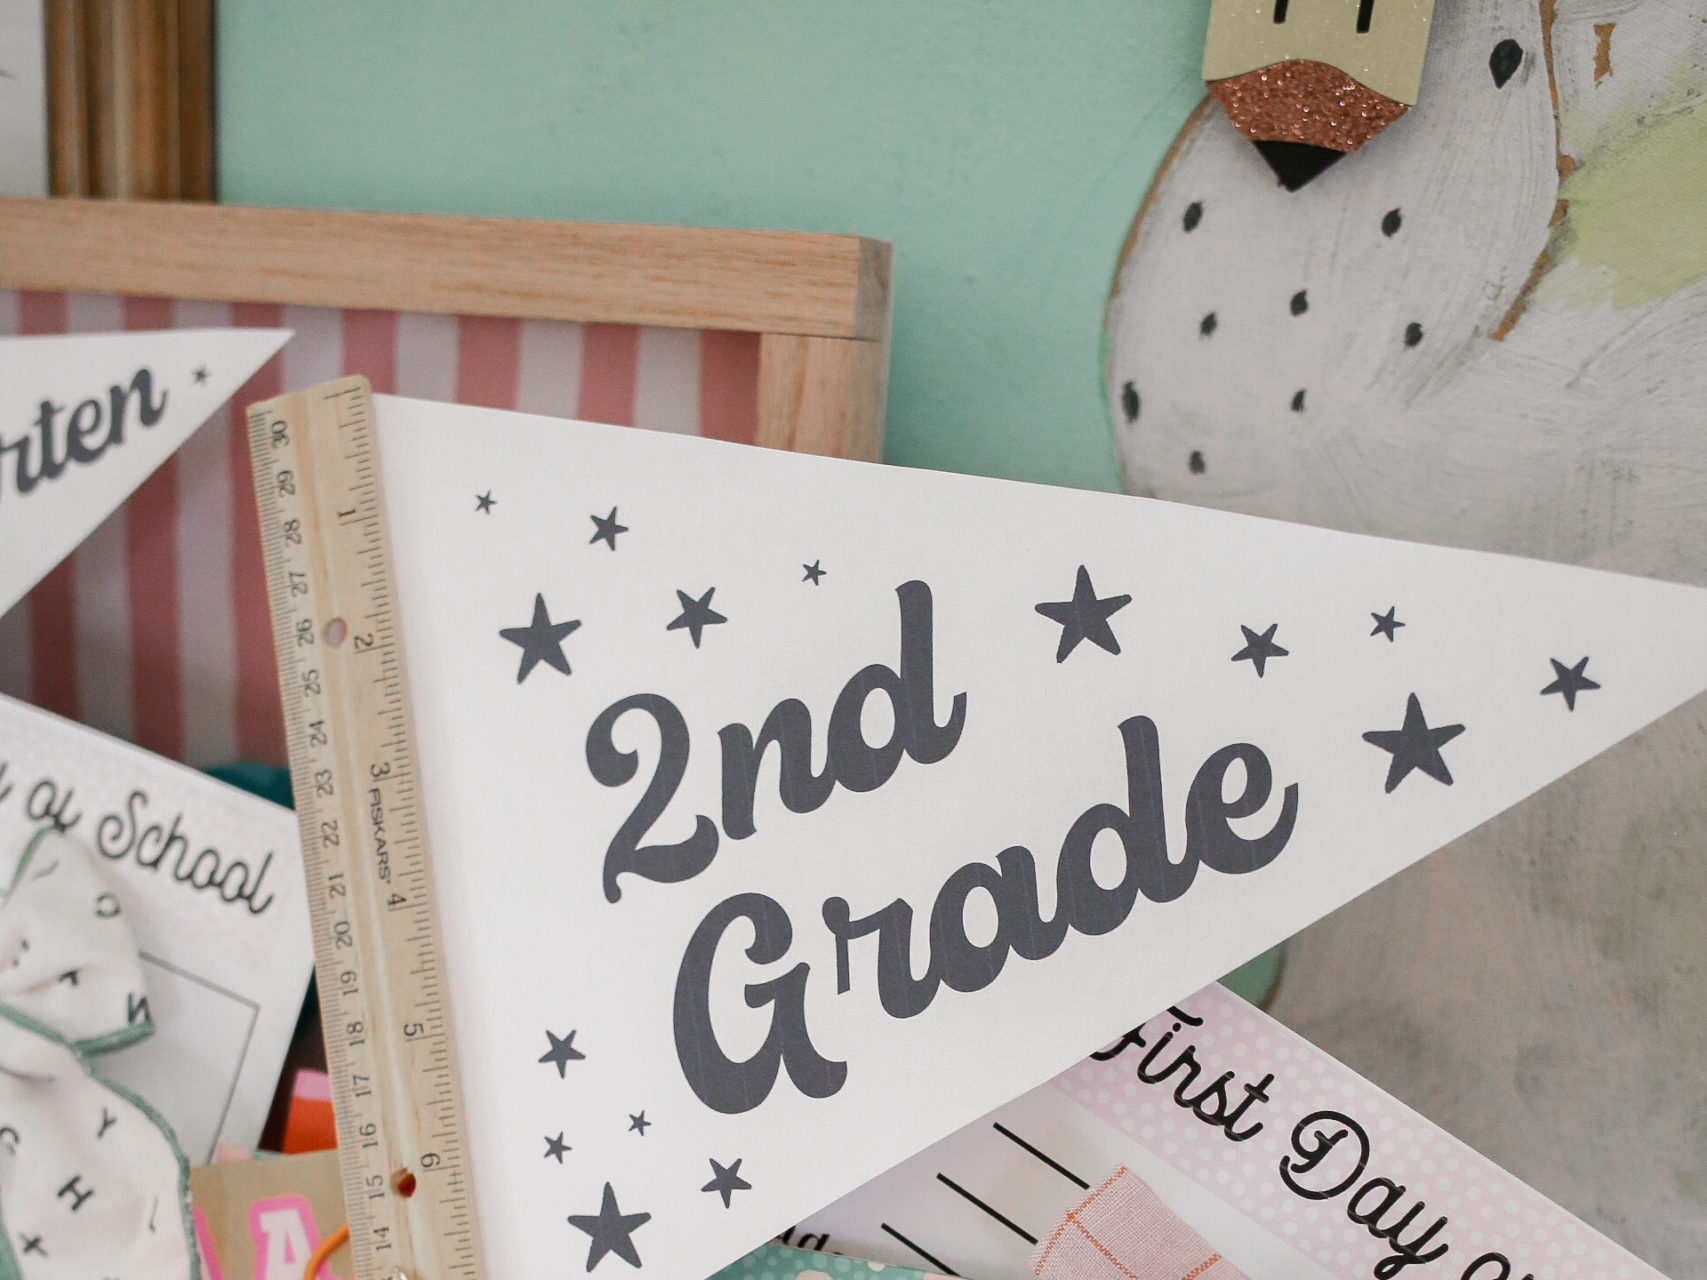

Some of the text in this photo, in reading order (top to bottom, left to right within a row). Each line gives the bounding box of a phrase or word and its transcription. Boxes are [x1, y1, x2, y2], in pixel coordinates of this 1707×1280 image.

[270, 420, 290, 449] 30
[275, 470, 296, 499] 29
[282, 518, 302, 547] 28
[288, 571, 309, 597] 27
[295, 617, 315, 647] 26
[302, 669, 322, 698] 25
[308, 719, 328, 749] 24
[585, 580, 967, 904] 2nd
[315, 769, 334, 796] 23
[338, 508, 358, 520] 1
[353, 633, 376, 650] 2
[370, 761, 391, 779] 3
[387, 892, 408, 907] 4
[404, 1022, 425, 1037] 5
[321, 819, 340, 848] 22
[96, 790, 275, 915] School
[328, 872, 346, 897] 21
[673, 715, 1299, 1115] Grade
[334, 920, 353, 949] 20
[340, 971, 358, 996] 19
[347, 1020, 365, 1047] 18
[352, 1074, 372, 1098] 17
[360, 1122, 379, 1148] 16
[367, 1174, 385, 1200] 15
[1279, 1110, 1449, 1280] Day
[374, 1226, 392, 1252] 14
